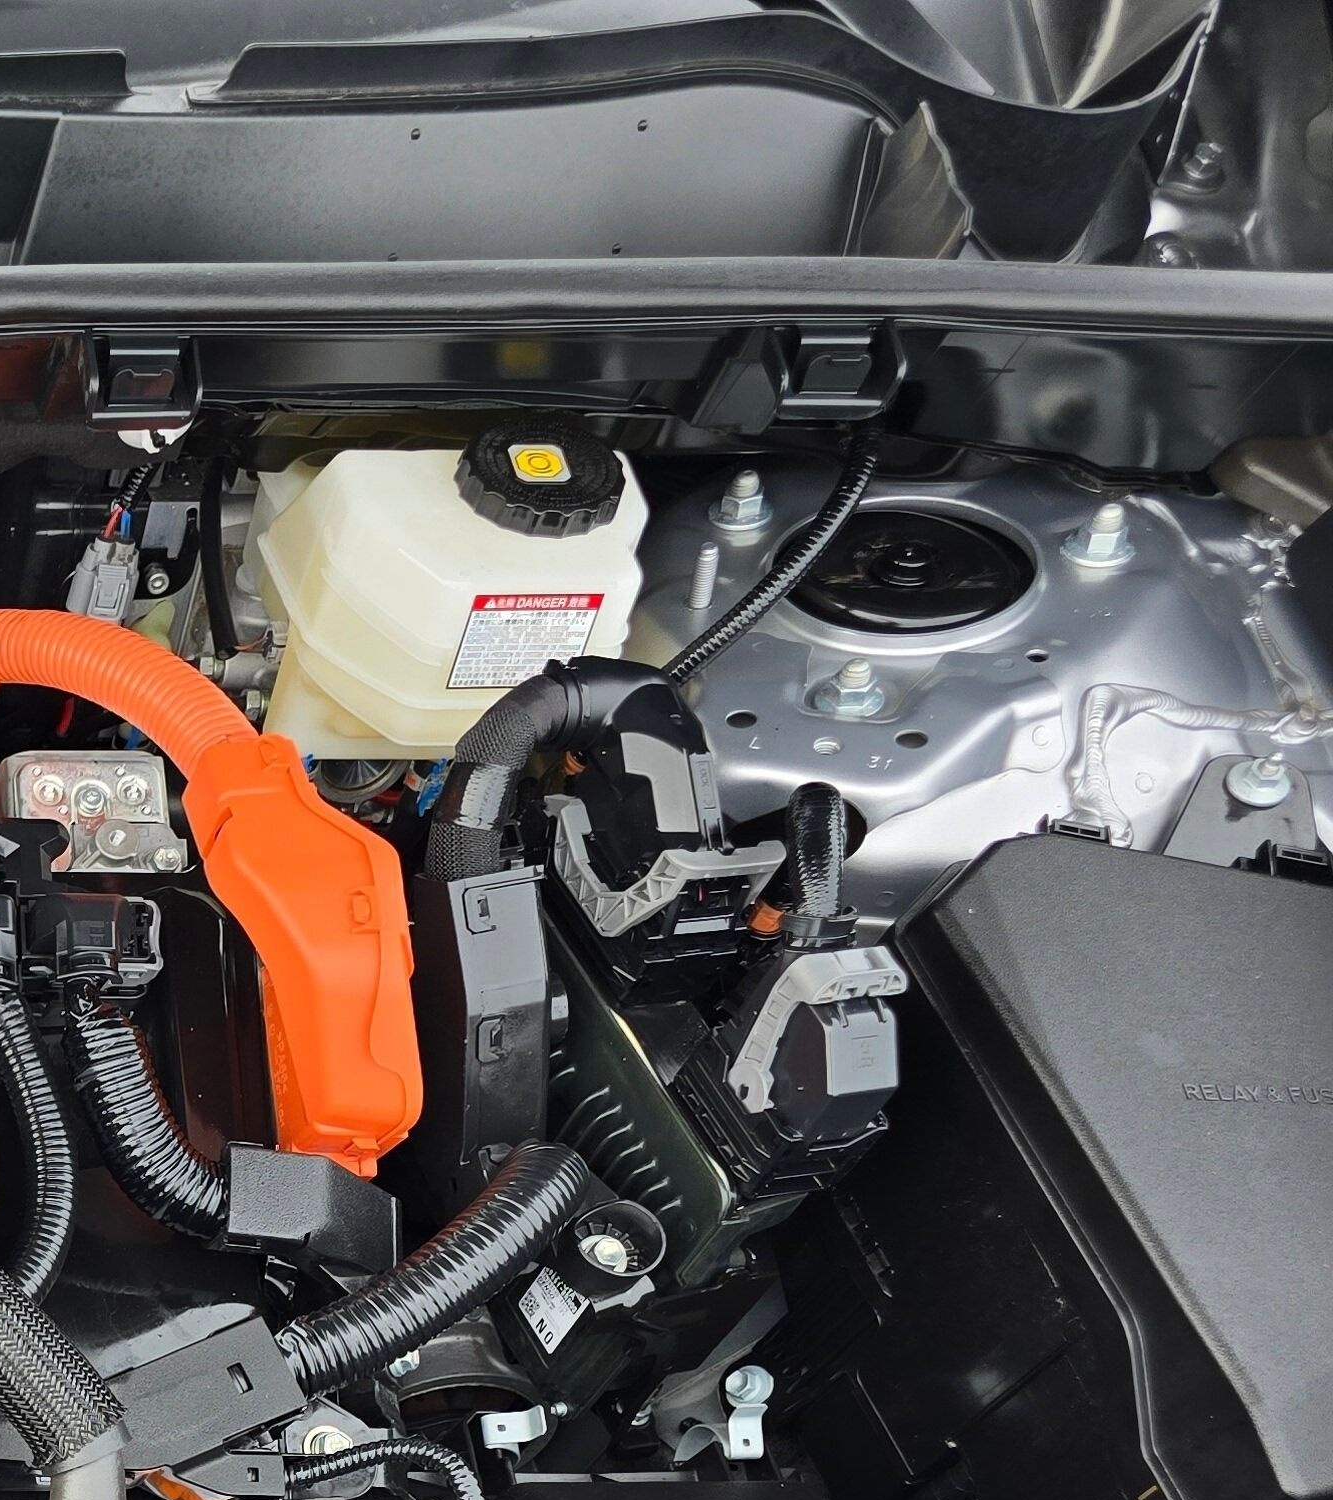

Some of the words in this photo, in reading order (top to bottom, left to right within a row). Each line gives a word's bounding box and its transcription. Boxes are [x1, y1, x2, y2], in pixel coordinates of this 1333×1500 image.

[516, 597, 566, 609] DANGER
[1183, 1083, 1260, 1103] RELAY
[1266, 1086, 1283, 1104] &
